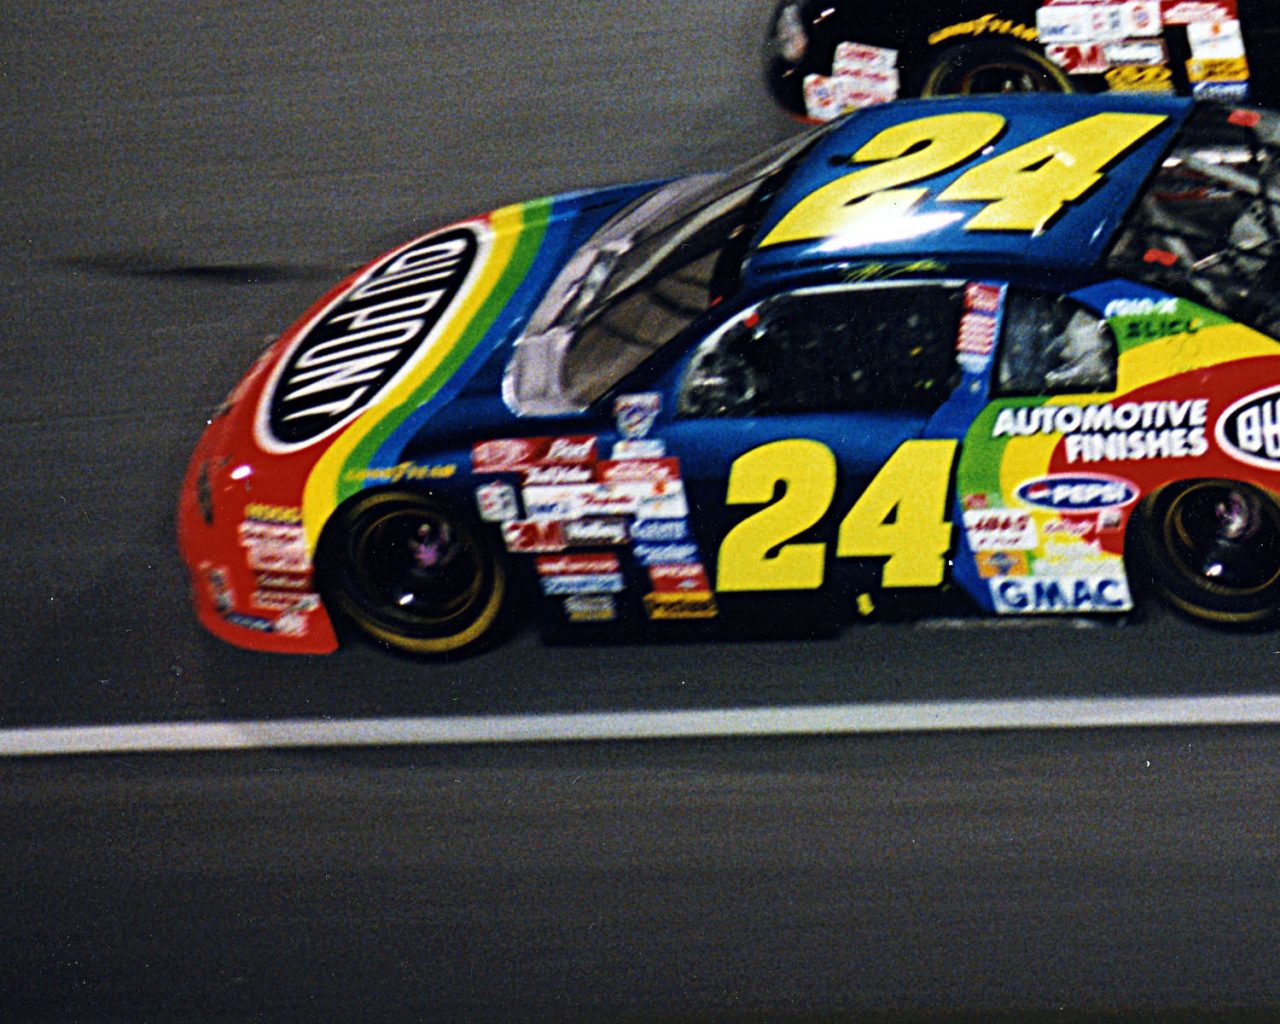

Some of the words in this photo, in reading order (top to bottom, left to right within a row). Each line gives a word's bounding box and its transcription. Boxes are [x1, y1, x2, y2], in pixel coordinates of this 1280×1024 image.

[758, 111, 1170, 248] 24
[992, 399, 1208, 437] AUTOMOTIVE
[1065, 428, 1208, 464] FINISHES
[717, 438, 957, 592] 24
[999, 579, 1124, 609] GMAC
